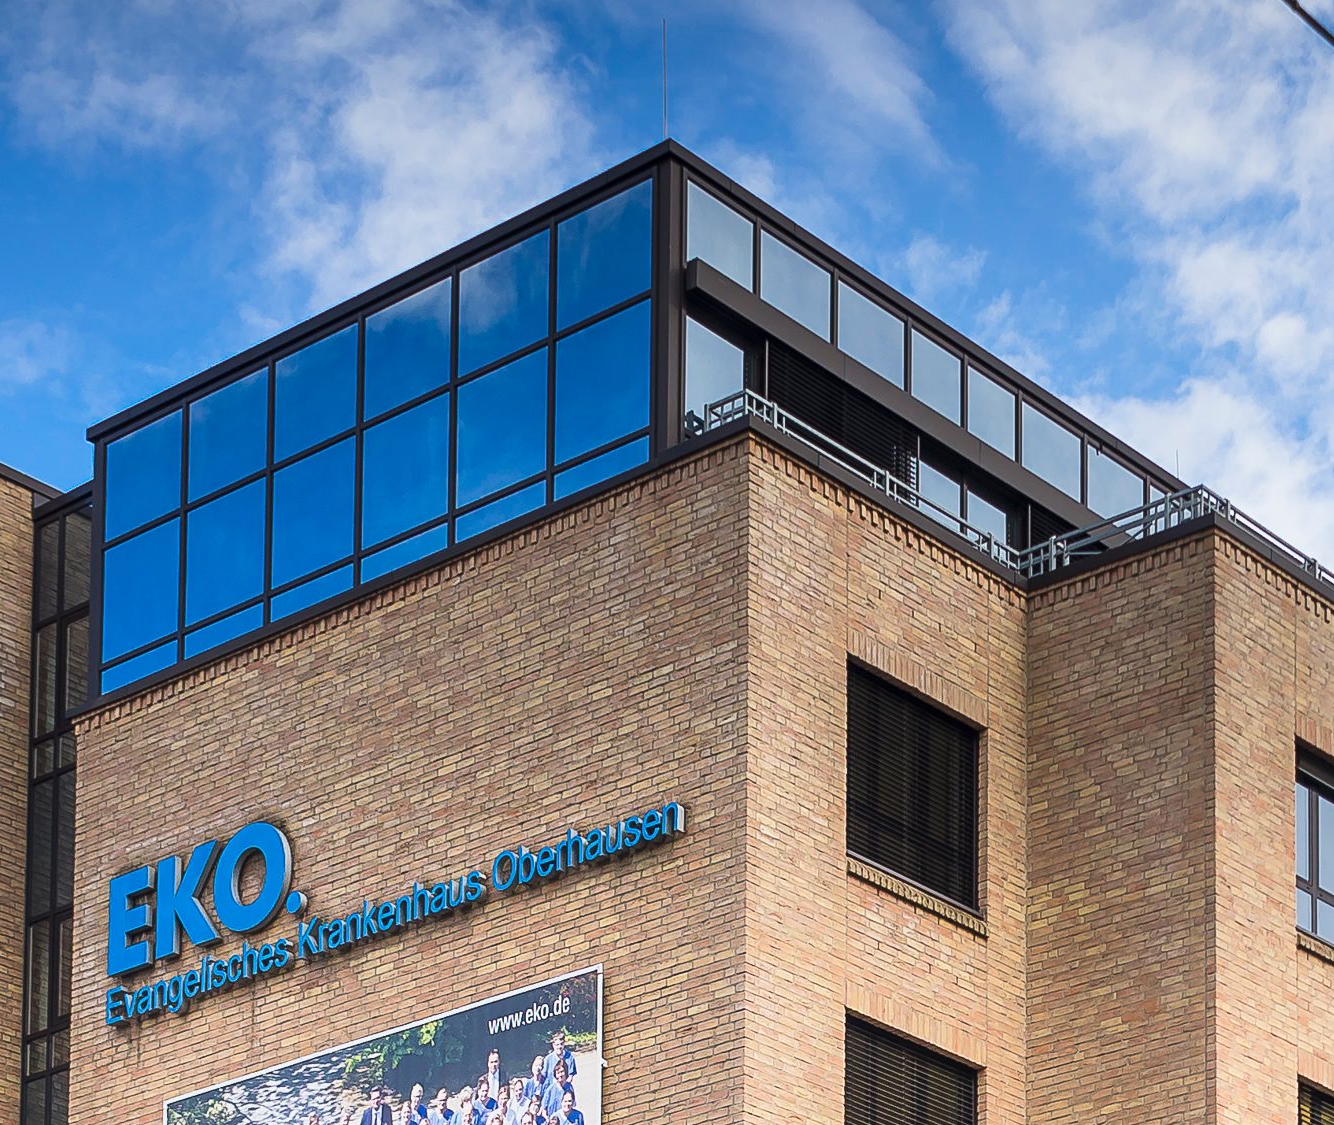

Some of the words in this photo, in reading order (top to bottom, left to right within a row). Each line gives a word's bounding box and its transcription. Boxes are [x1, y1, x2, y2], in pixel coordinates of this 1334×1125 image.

[105, 937, 293, 1025] Evangelisches
[298, 870, 486, 958] Krankenhaus
[492, 801, 685, 891] Oberhausen
[107, 821, 304, 977] EKO.
[488, 994, 571, 1035] www.eko.de
